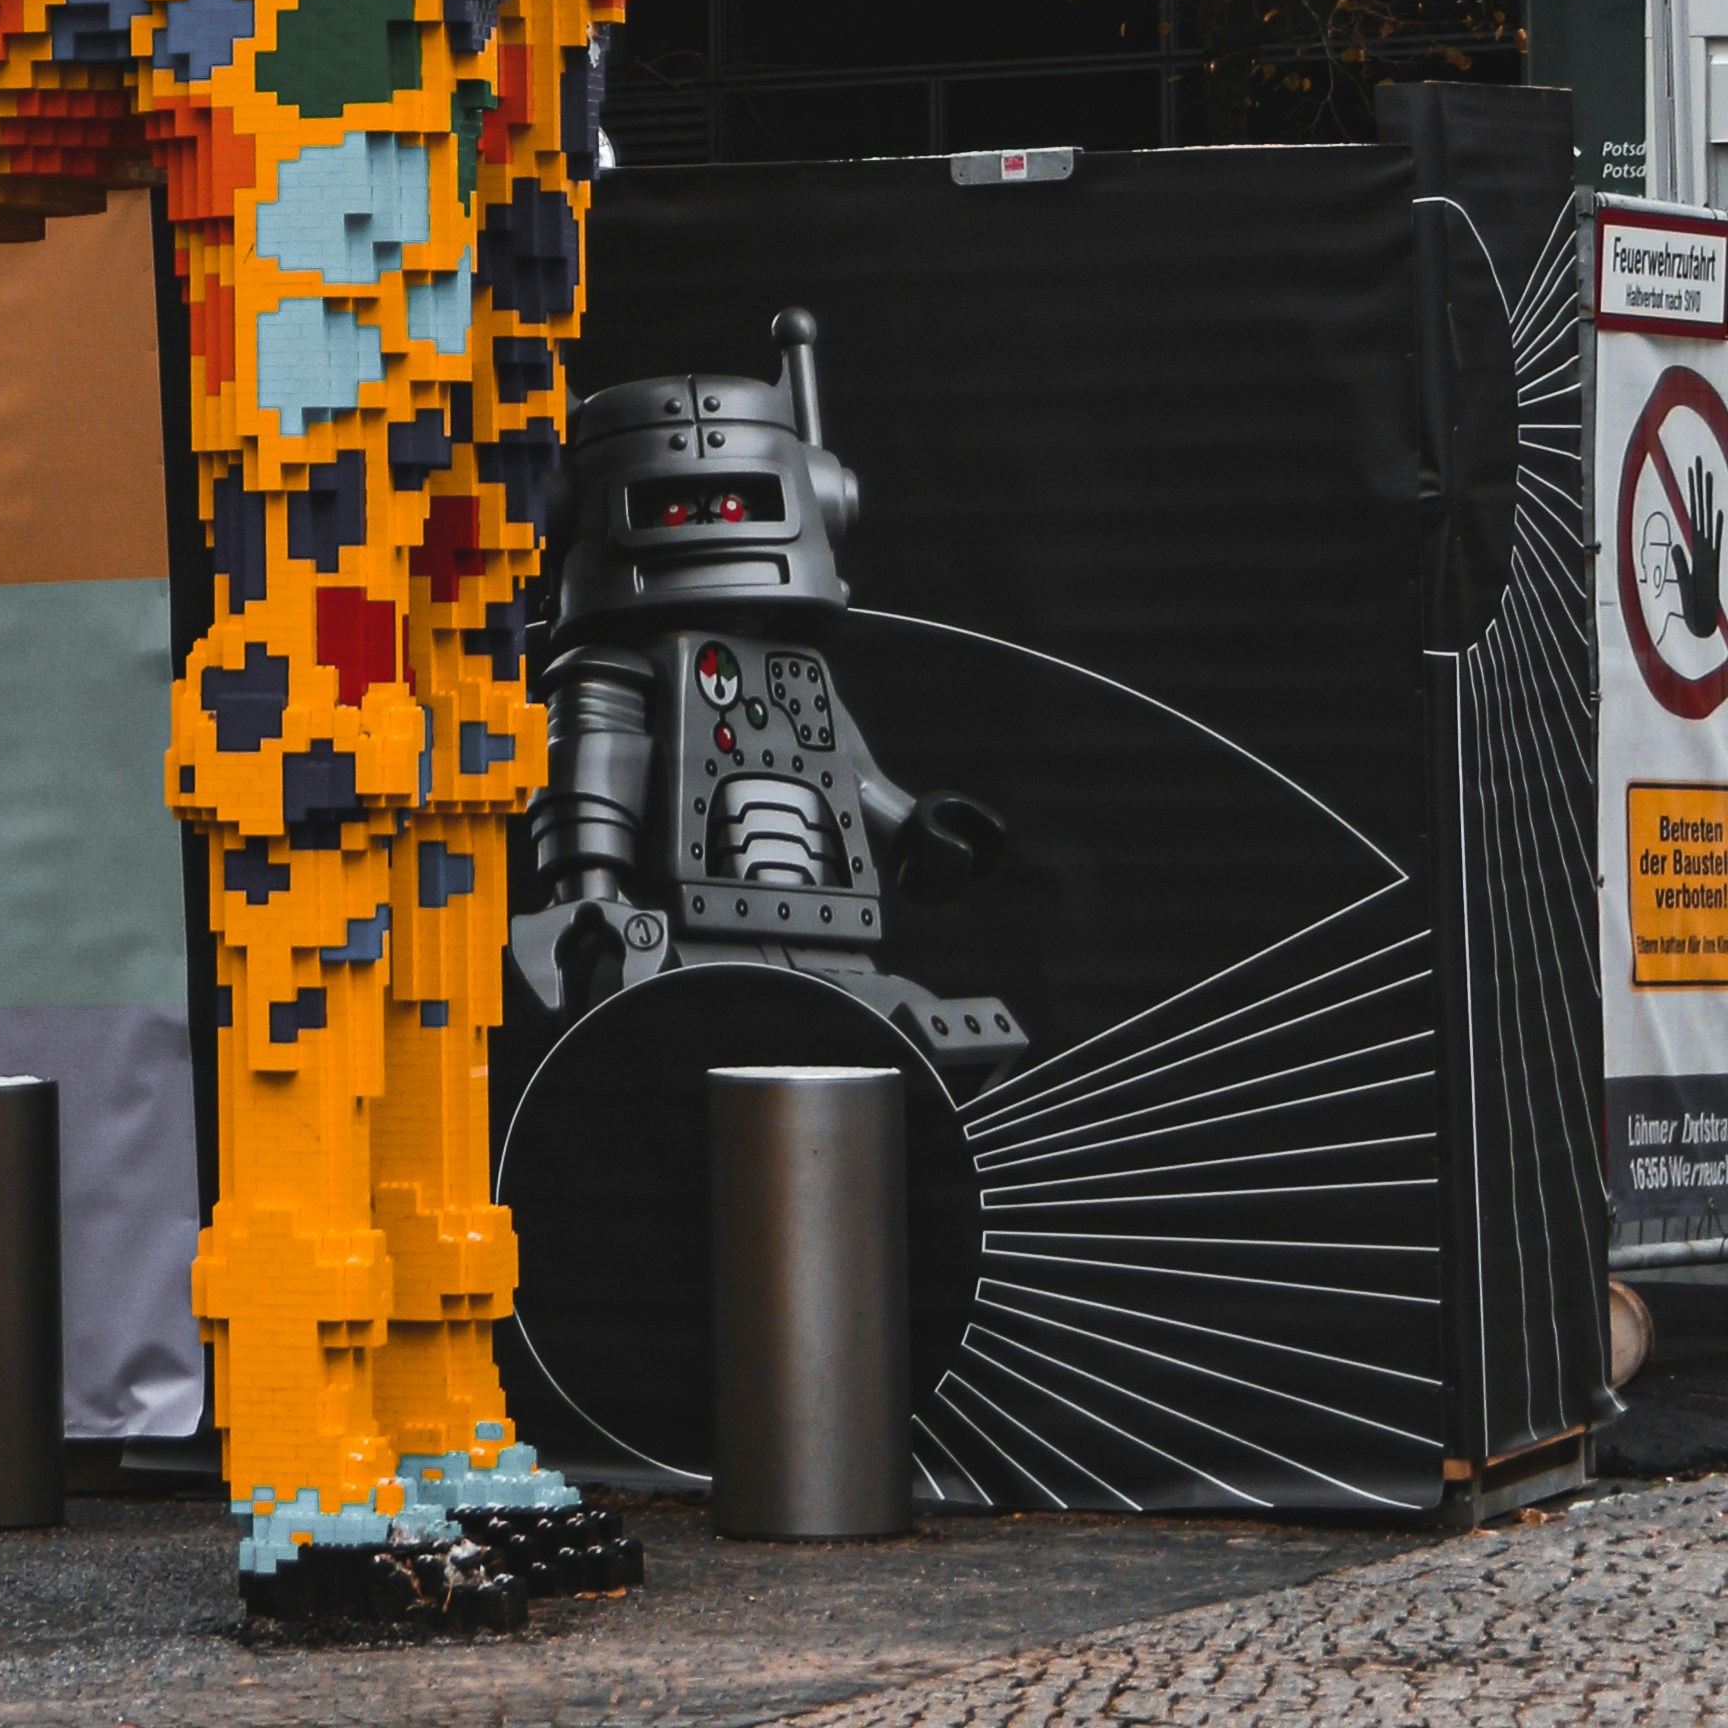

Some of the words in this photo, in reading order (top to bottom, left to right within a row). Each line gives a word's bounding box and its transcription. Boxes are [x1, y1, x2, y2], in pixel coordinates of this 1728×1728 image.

[1612, 237, 1716, 282] Feuerwehrzufahrt
[1659, 815, 1723, 843] Betreten
[1639, 848, 1668, 876] der
[1655, 883, 1728, 910] verboten!
[1628, 1113, 1679, 1147] Löhmer
[1629, 1155, 1669, 1190] 16356
